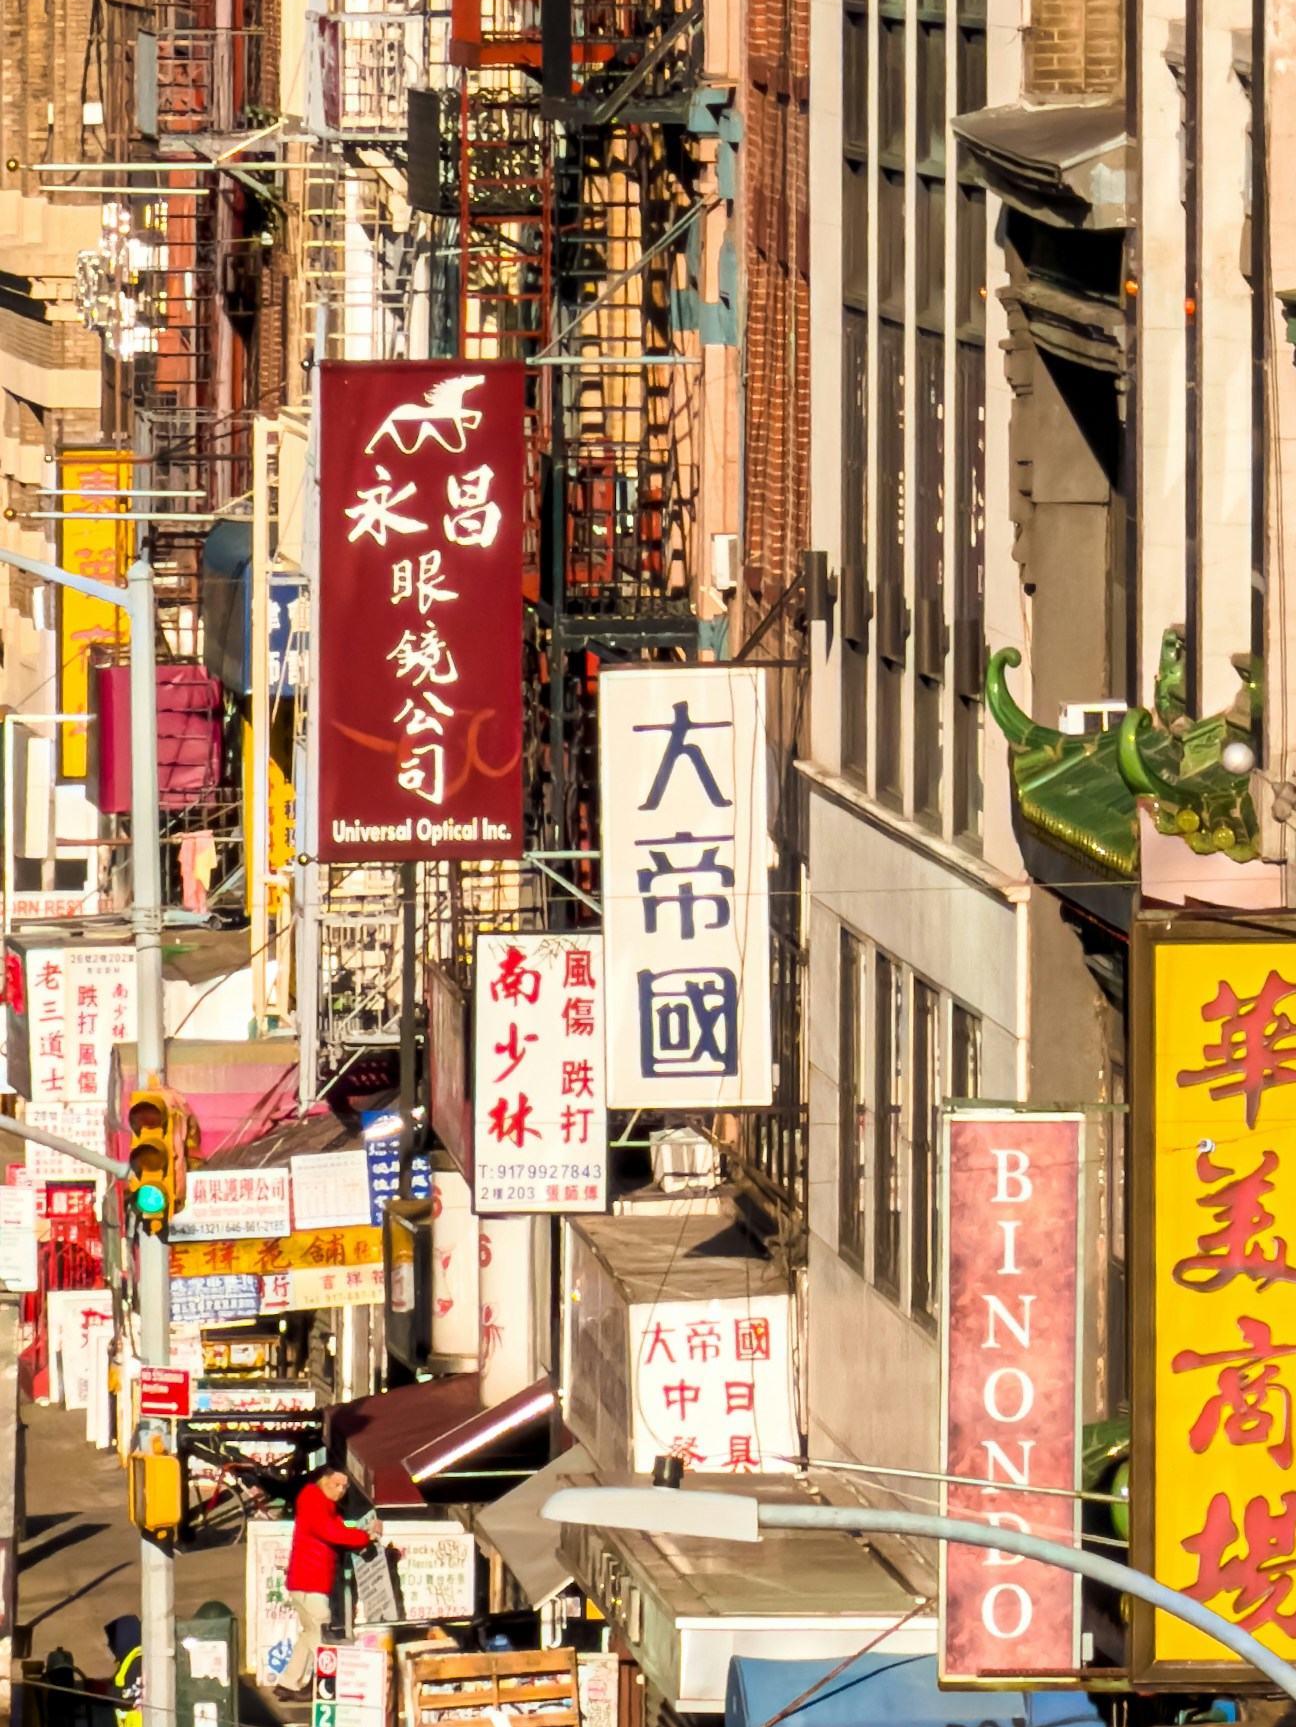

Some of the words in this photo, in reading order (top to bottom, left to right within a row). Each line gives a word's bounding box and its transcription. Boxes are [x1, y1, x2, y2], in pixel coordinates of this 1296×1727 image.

[344, 464, 502, 547] 永昌
[386, 548, 459, 806] 眼鏡公司
[332, 819, 412, 843] Universal
[416, 817, 478, 846] Optical
[482, 817, 512, 841] Inc.
[633, 701, 738, 1078] 大帝國
[34, 960, 65, 1092] 老三道士
[77, 984, 98, 1094] 跌打風傷
[487, 946, 543, 1148] 南少林
[561, 1059, 595, 1144] 跌打
[641, 1317, 771, 1365] 大帝國
[981, 1148, 1037, 1640] BINONDO
[319, 1705, 332, 1727] 2
